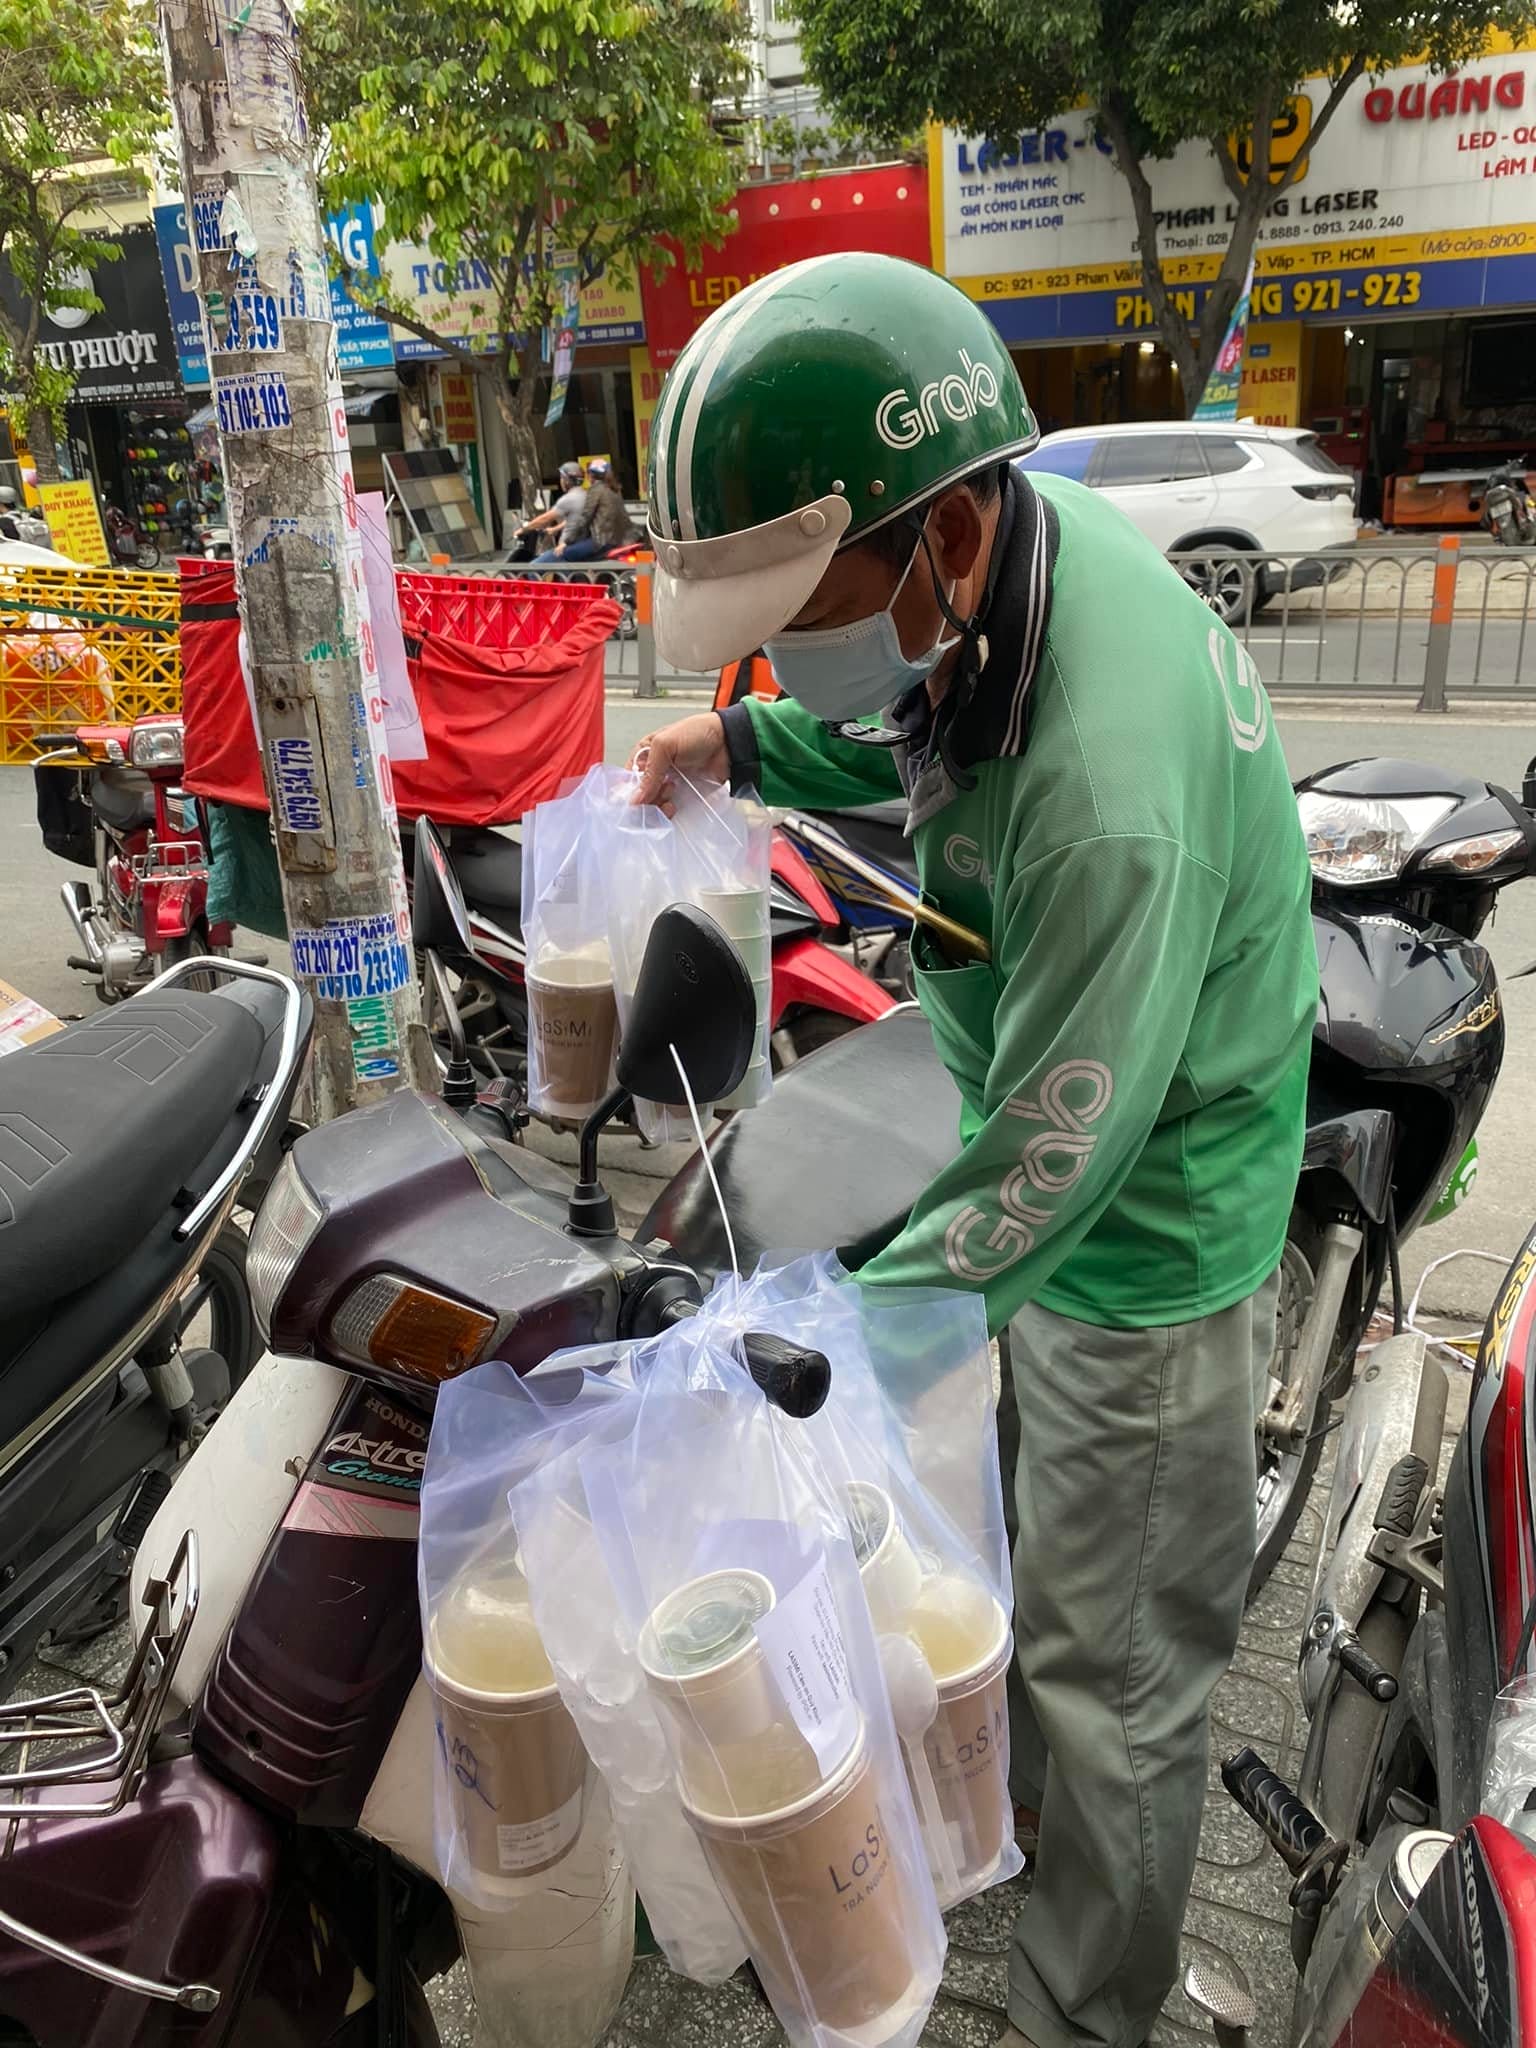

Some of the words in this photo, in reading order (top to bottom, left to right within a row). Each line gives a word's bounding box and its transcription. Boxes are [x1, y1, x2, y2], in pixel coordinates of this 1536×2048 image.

[1457, 131, 1497, 151] LED
[960, 183, 985, 197] TEM
[1020, 193, 1059, 211] LASER
[1301, 189, 1379, 216] LASER
[1206, 233, 1228, 246] 028
[984, 279, 1009, 294] ĐC:
[1012, 277, 1034, 291] 921
[1047, 273, 1070, 288] 923
[1076, 270, 1109, 286] Phan
[1339, 246, 1375, 262] HCM
[1116, 289, 1195, 328] PHN
[69, 330, 158, 373] PHƯỢT
[1251, 366, 1297, 385] LASER
[875, 347, 998, 450] Grab
[1359, 915, 1422, 940] HONDA
[945, 1058, 1114, 1282] Grab
[366, 1398, 429, 1441] HOND
[325, 1431, 427, 1473] Astre
[1462, 1840, 1490, 2020] HONDA
